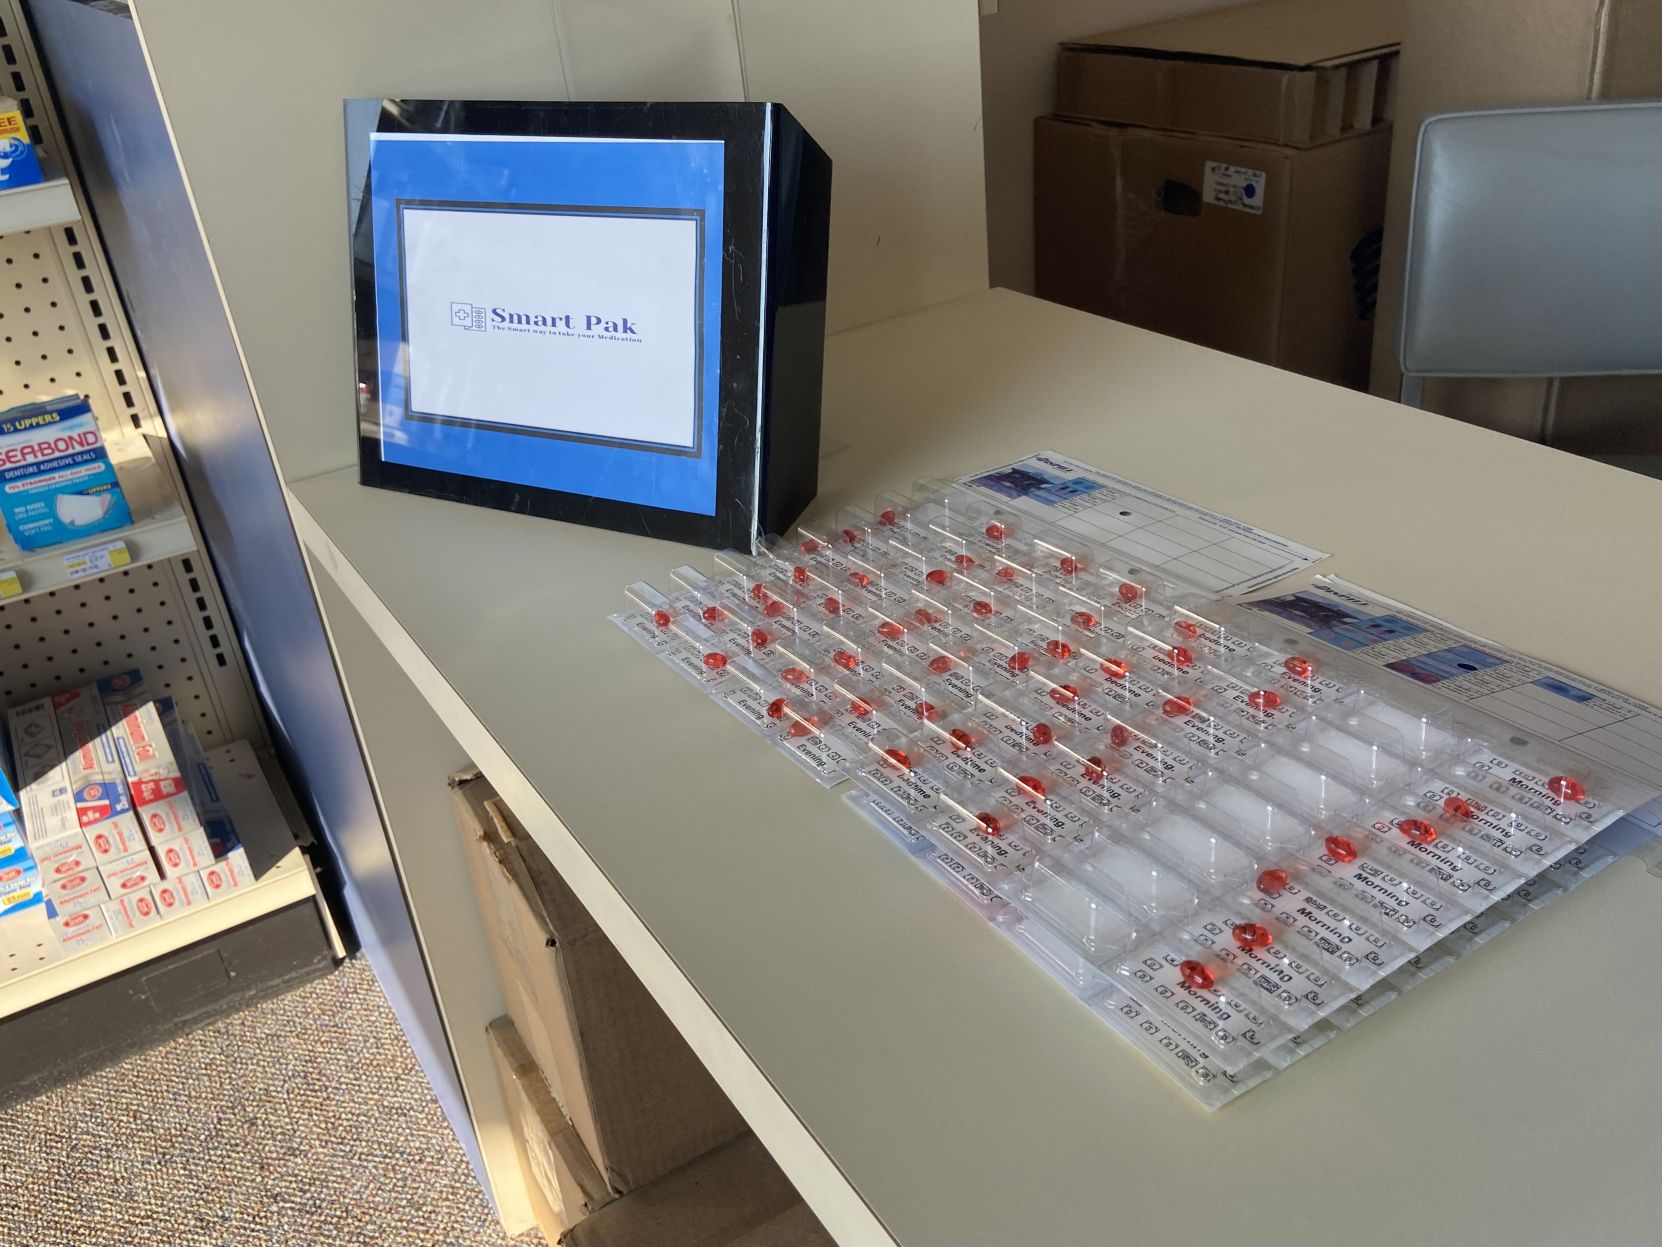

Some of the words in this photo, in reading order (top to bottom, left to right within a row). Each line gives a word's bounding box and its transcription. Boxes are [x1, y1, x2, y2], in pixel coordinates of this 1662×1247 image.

[491, 307, 576, 330] Smart
[584, 314, 638, 335] Pak
[507, 326, 531, 334] Smart
[558, 330, 575, 338] take
[597, 334, 642, 344] Medication
[15, 411, 61, 430] UPPERS
[4, 464, 39, 480] DENTURE
[40, 457, 74, 472] ADHESIVE
[74, 451, 96, 463] SEALS
[1198, 633, 1236, 653] bedtme
[1152, 654, 1190, 675] bedtme
[1104, 676, 1142, 698] bedtme
[737, 698, 766, 721] Evening
[1507, 776, 1562, 807] Morning
[1406, 838, 1464, 873] Morning
[1352, 871, 1411, 908] Morning
[1296, 906, 1353, 945] Morning
[1236, 943, 1295, 984] Morning
[1175, 979, 1232, 1022] Morning
